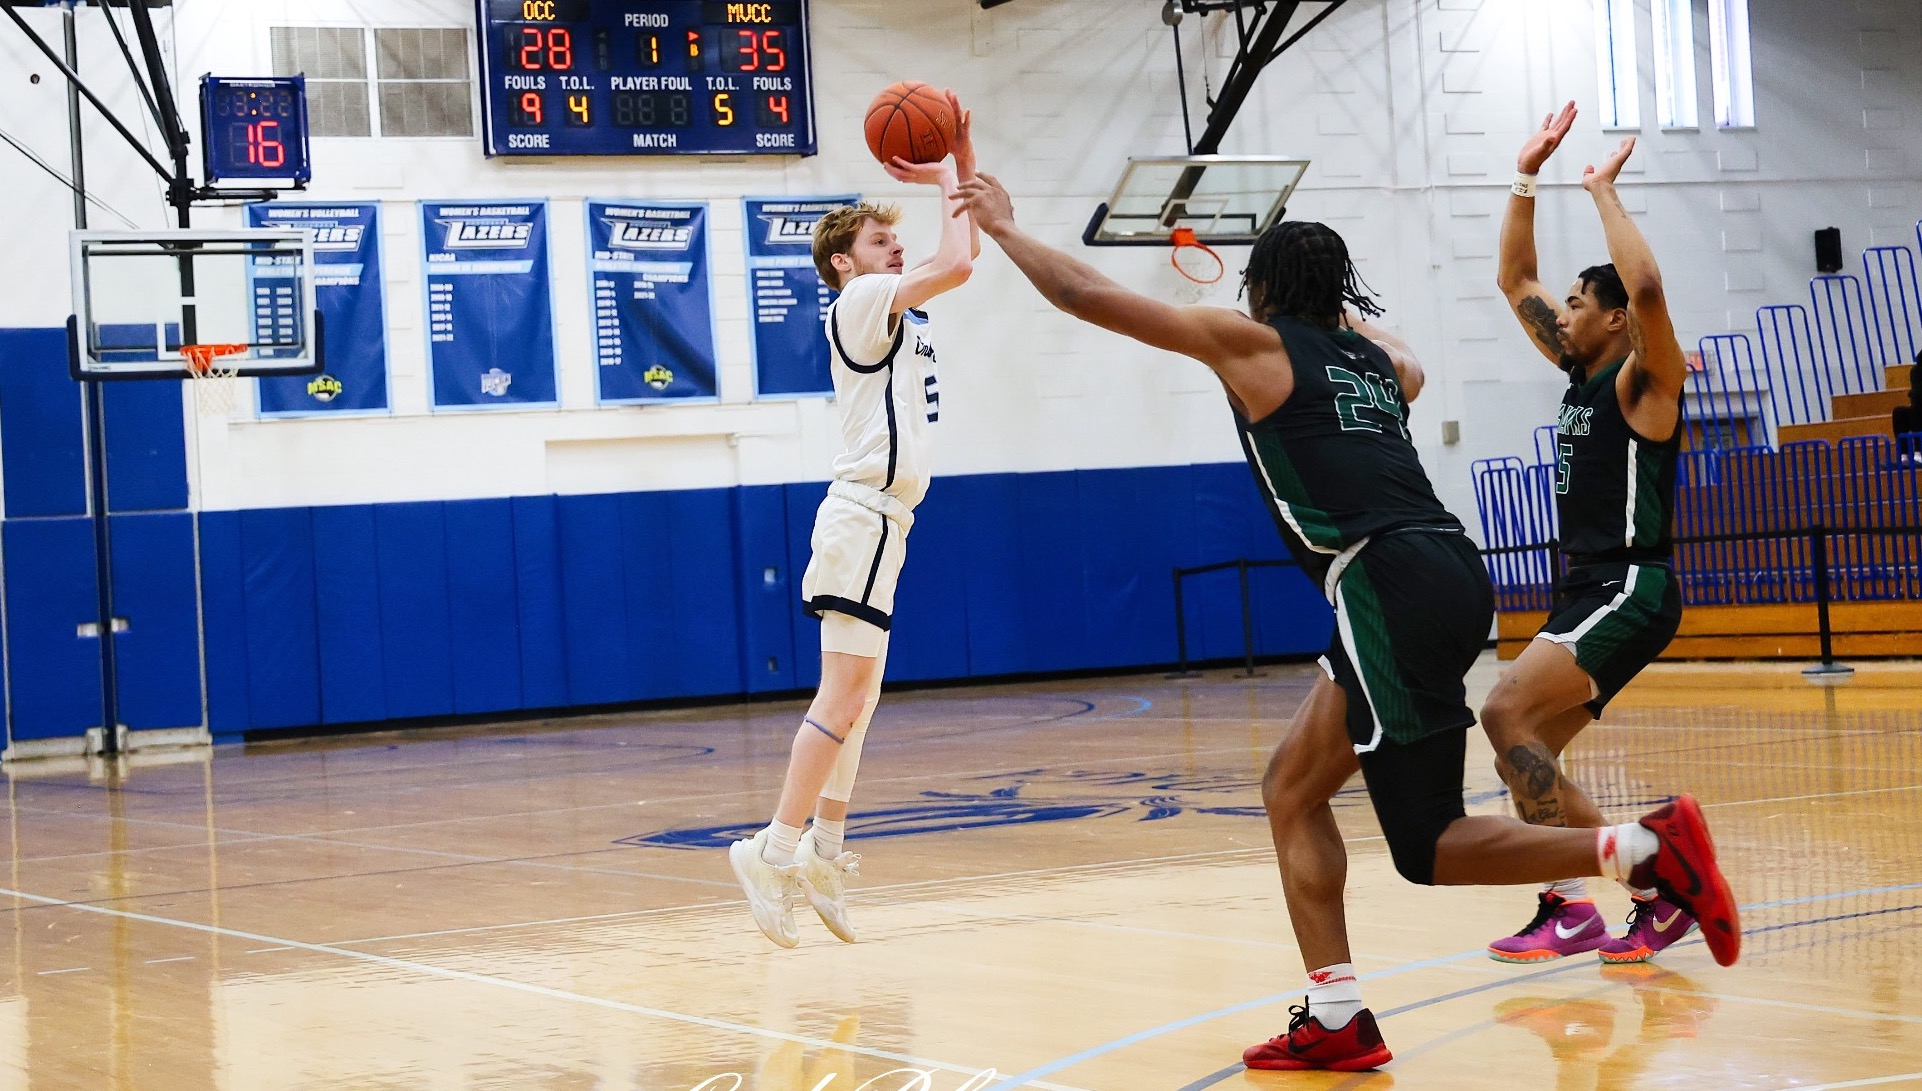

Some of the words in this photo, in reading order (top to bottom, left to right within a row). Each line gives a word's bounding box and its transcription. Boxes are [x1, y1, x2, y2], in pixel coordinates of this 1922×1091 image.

[523, 0, 556, 20] OCC
[625, 13, 669, 28] PERIOD
[727, 3, 772, 23] MVCC
[521, 28, 572, 70] 28
[650, 36, 659, 64] 1
[737, 30, 786, 71] 35
[504, 75, 547, 90] FOULS
[559, 76, 595, 91] T.O.L.
[610, 76, 658, 91] PLAYER
[660, 76, 693, 91] FOUL
[706, 76, 740, 91] T.O.L.
[753, 76, 792, 91] FOULS
[521, 92, 542, 124] 9
[568, 94, 588, 123] 4
[714, 93, 734, 126] 5
[767, 95, 788, 123] 4
[246, 120, 285, 167] 16
[508, 134, 550, 148] SCORE
[633, 133, 677, 148] MATCH
[755, 133, 795, 147] SCORE
[446, 221, 530, 247] LAZERS
[611, 222, 689, 248] LAZERS
[768, 217, 813, 241] LAZ
[1556, 443, 1573, 494] 5
